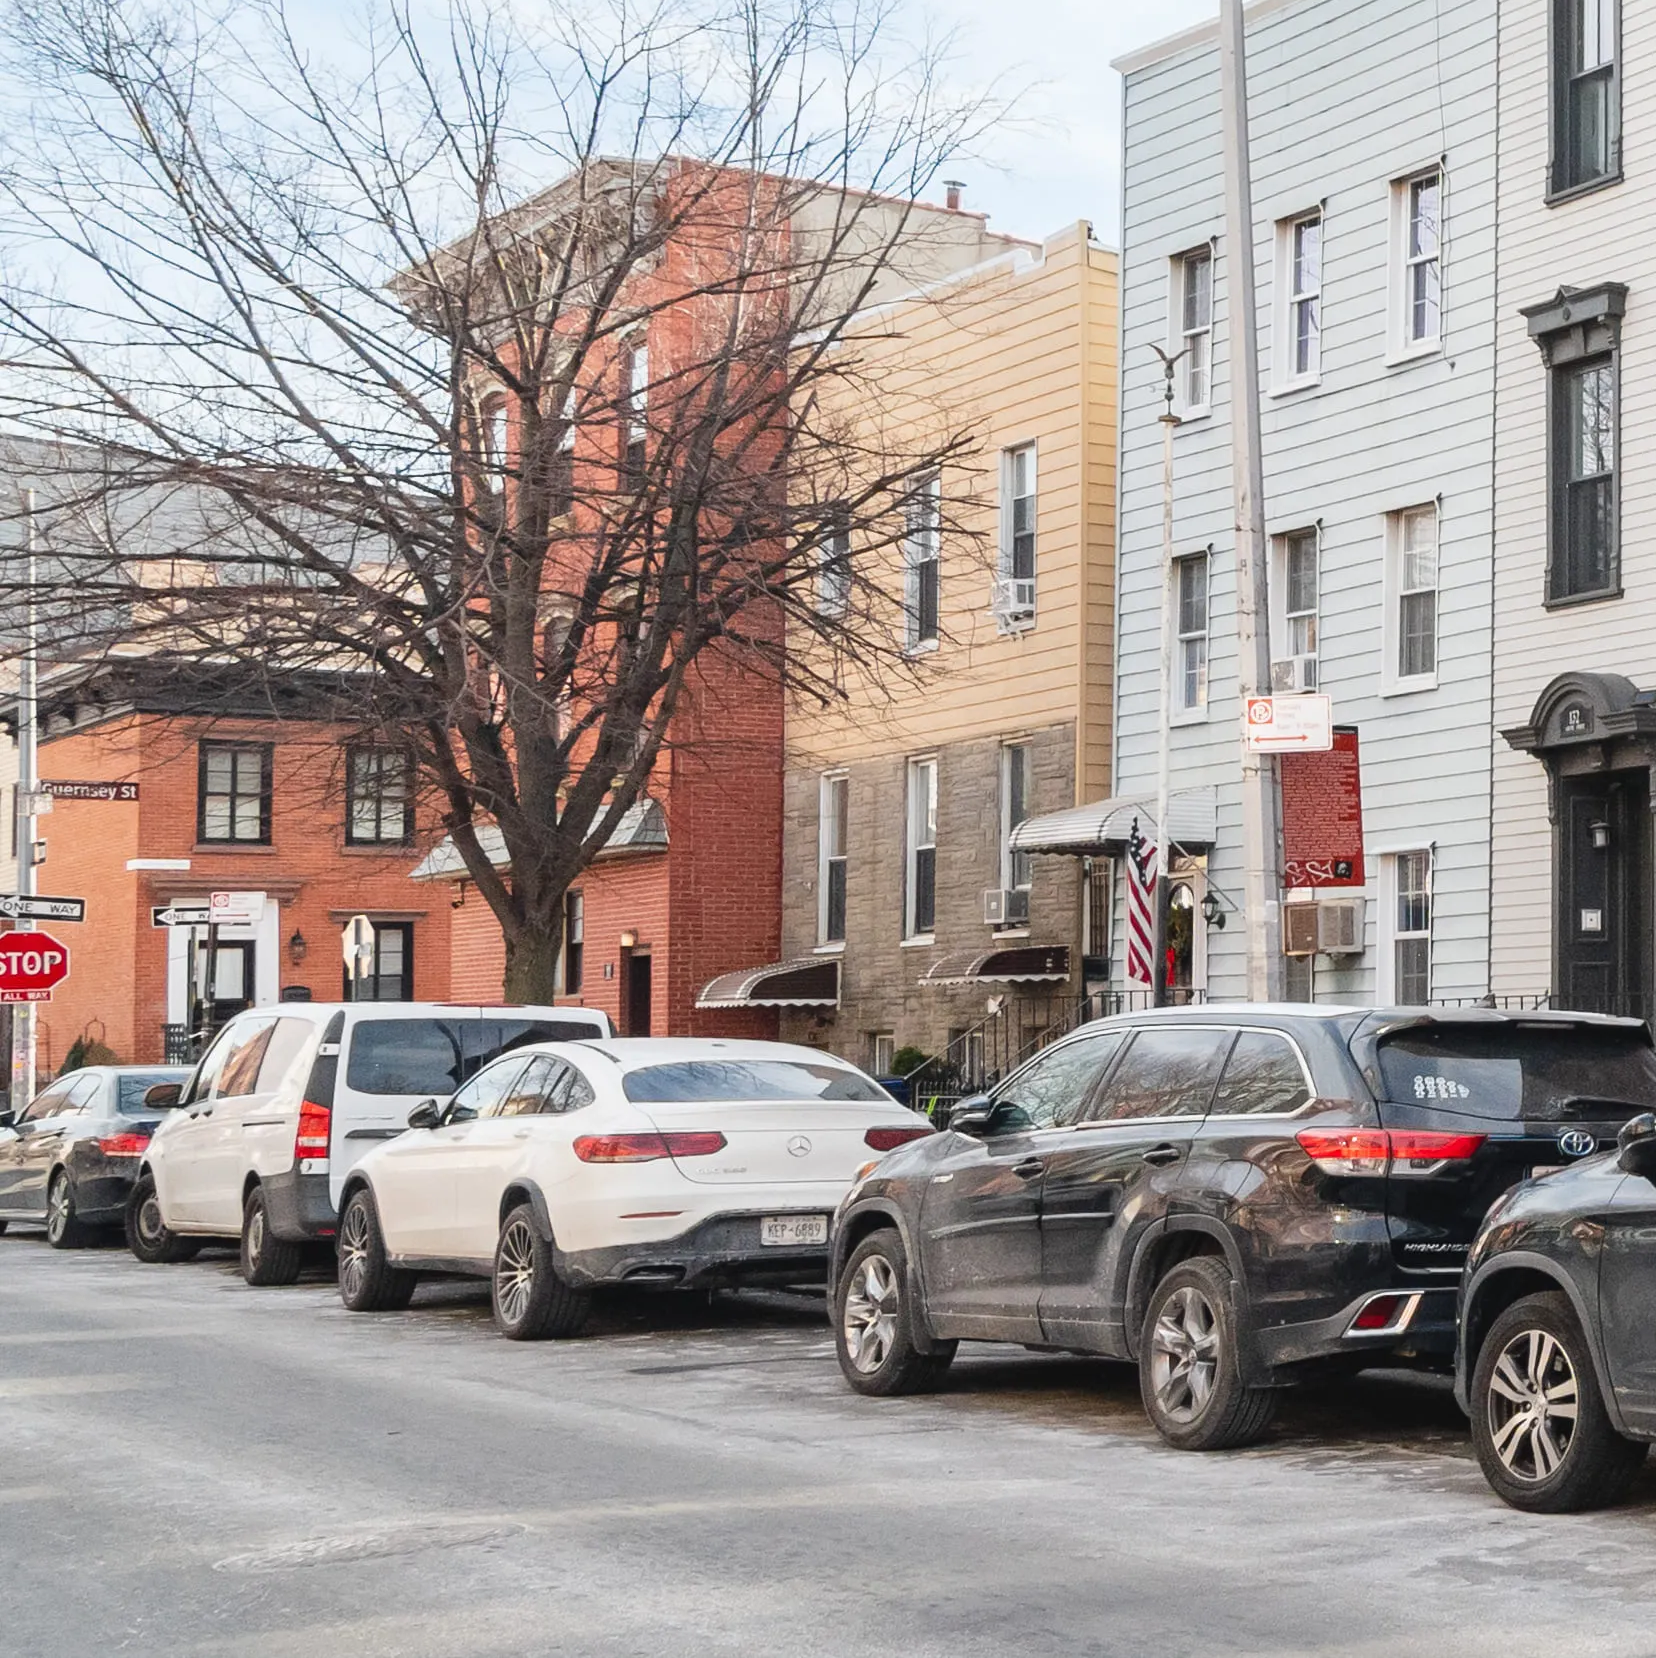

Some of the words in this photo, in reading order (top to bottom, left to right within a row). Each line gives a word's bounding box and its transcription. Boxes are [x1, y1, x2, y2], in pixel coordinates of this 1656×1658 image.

[41, 782, 118, 800] Guernsey
[120, 785, 137, 799] St
[3, 902, 34, 913] ONE
[49, 904, 78, 914] WAY
[3, 992, 24, 1001] ALL
[26, 991, 49, 1000] WAY
